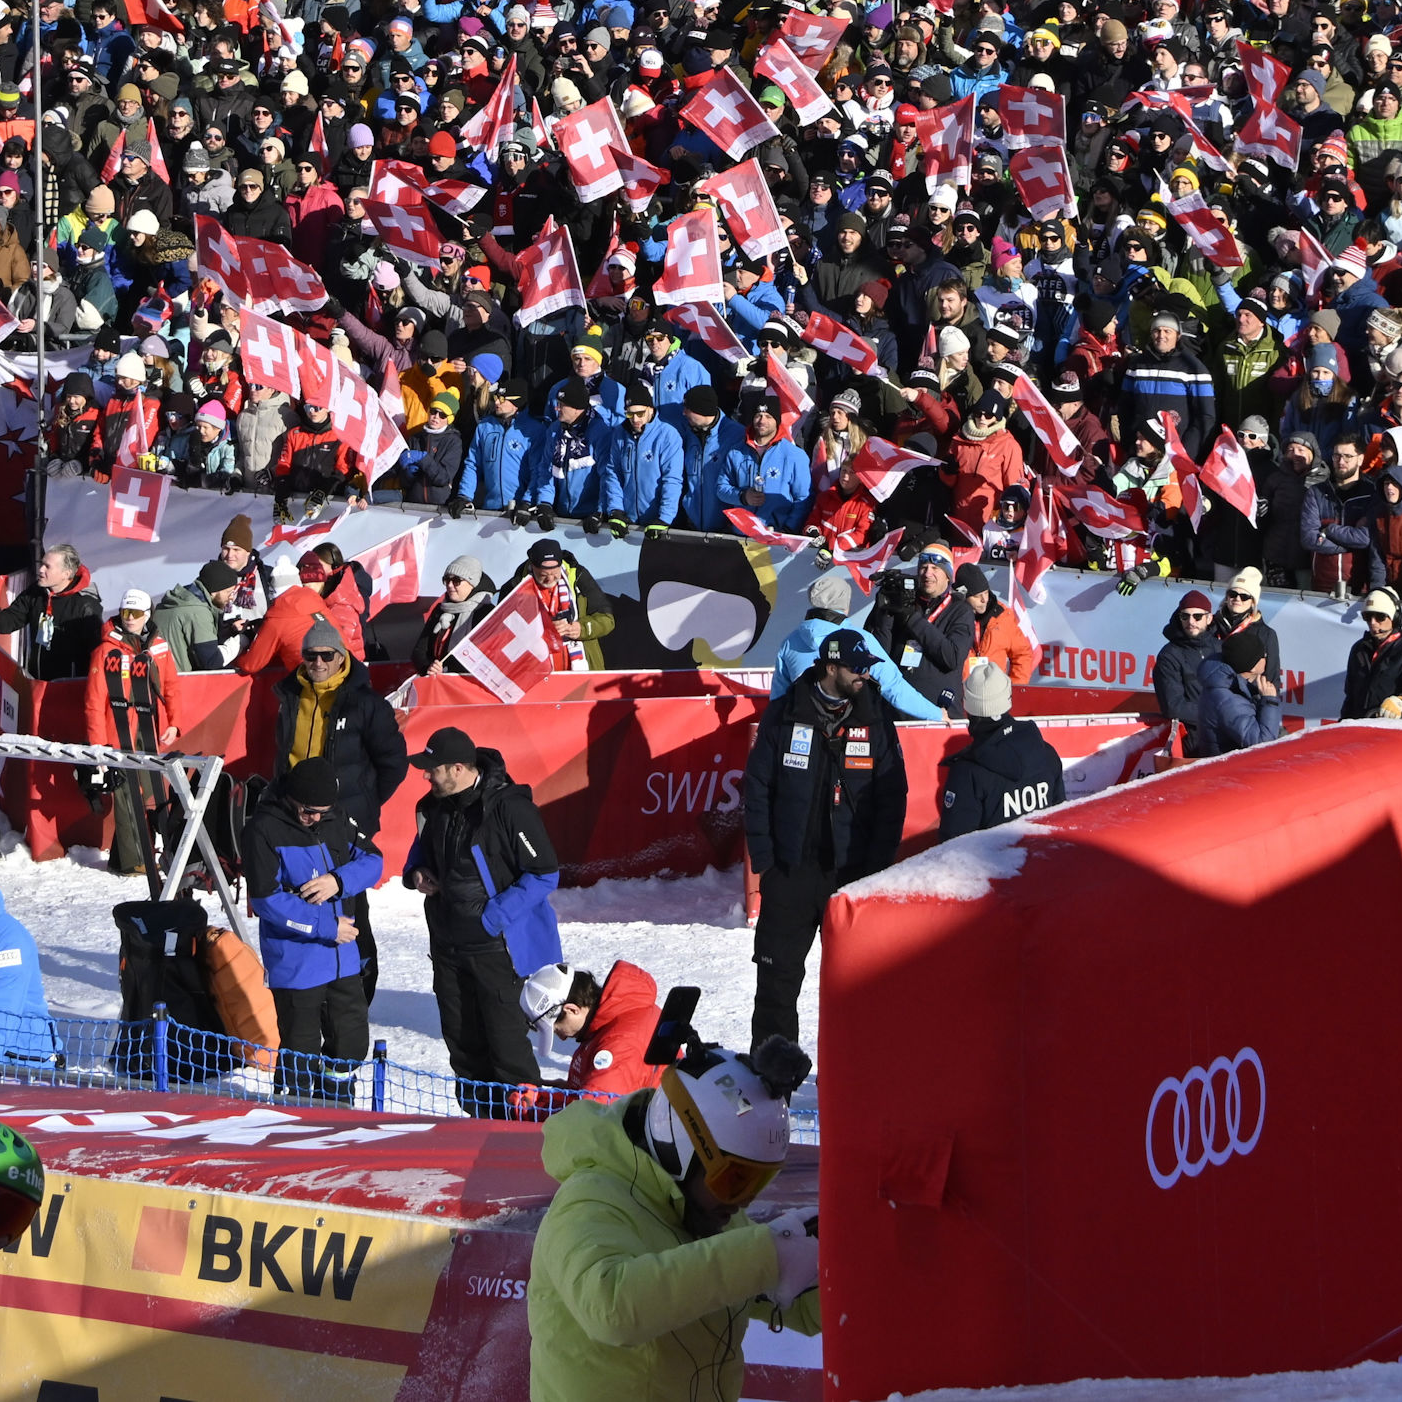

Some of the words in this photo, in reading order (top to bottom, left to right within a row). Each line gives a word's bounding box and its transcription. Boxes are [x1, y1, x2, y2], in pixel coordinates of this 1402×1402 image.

[828, 651, 841, 659] HH
[1040, 648, 1136, 682] ELTCUP
[794, 742, 807, 751] 5G
[849, 728, 866, 738] HH
[784, 758, 806, 767] KPMG
[849, 744, 866, 754] DNB
[641, 753, 745, 815] swis
[1003, 781, 1049, 818] NOR
[518, 831, 538, 858] SALOMON
[684, 1108, 714, 1160] HEAD
[7, 1164, 44, 1192] e-the
[198, 1214, 372, 1302] BKW
[465, 1271, 527, 1300] swiss
